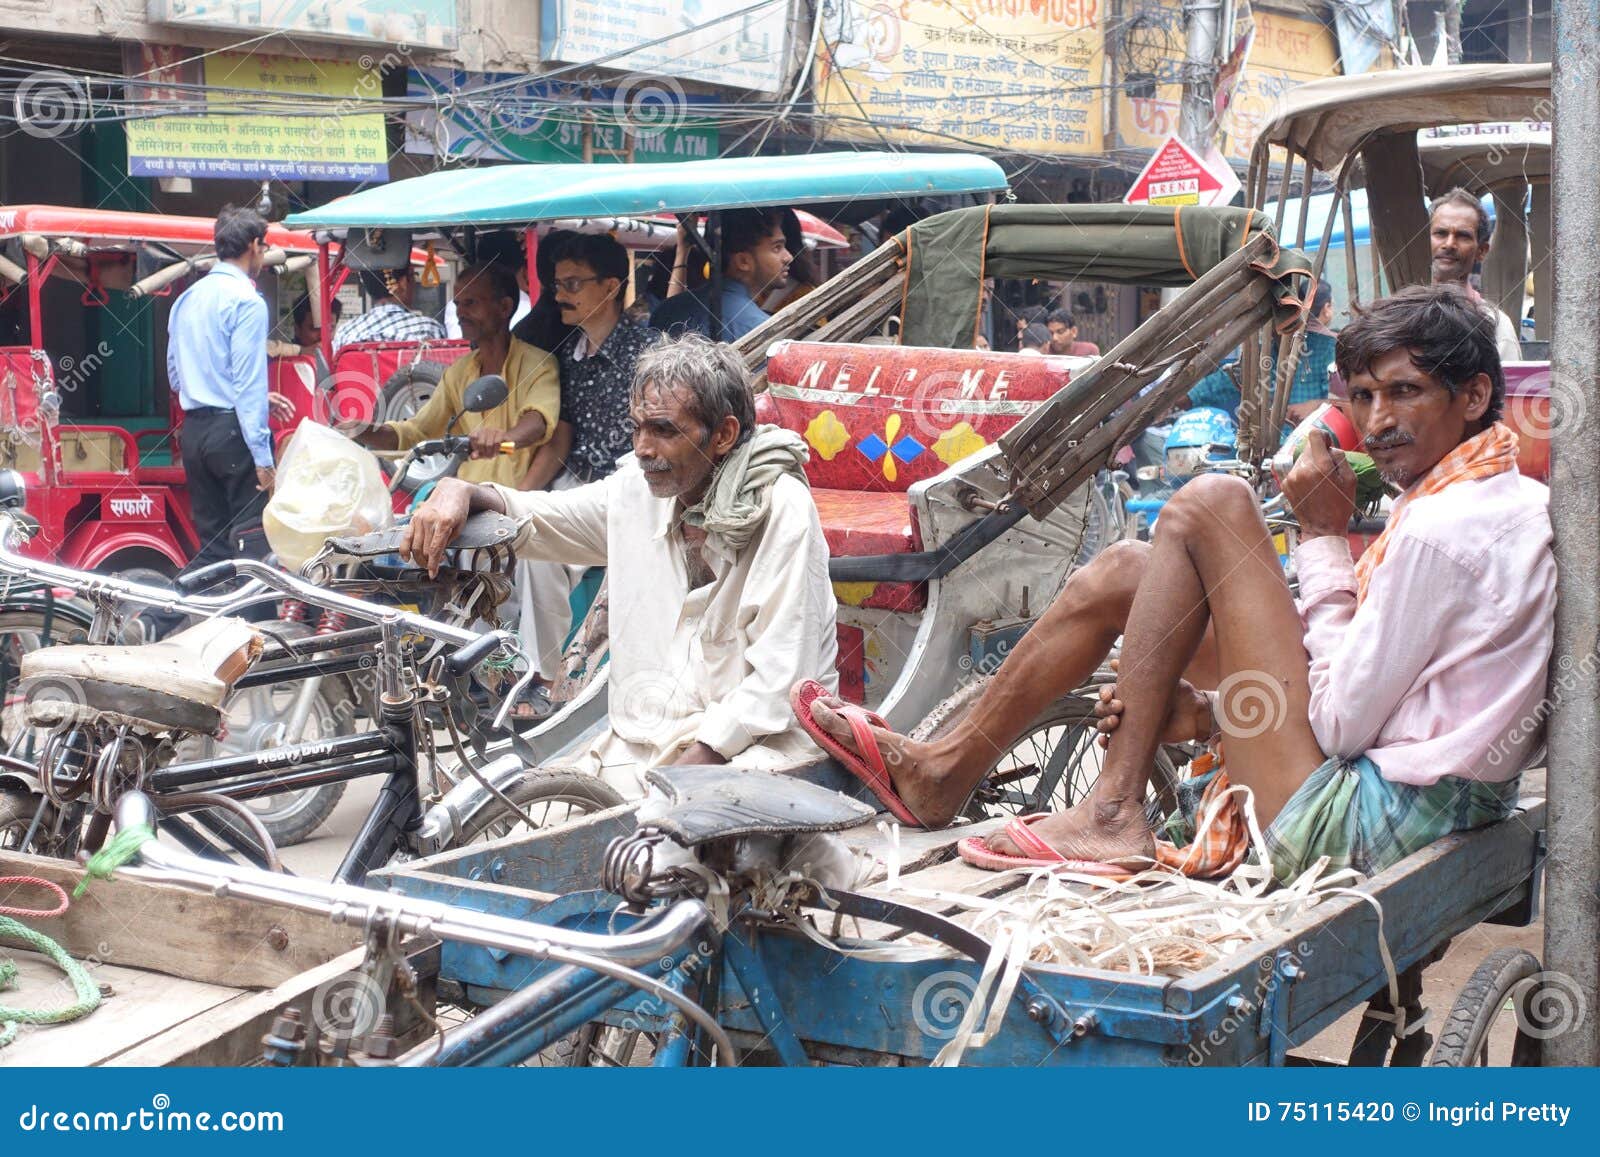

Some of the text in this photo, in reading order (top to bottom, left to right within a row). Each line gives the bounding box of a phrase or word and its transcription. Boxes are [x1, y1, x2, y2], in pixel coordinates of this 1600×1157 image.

[559, 123, 615, 148] STTE
[673, 135, 708, 157] ATM
[1150, 181, 1197, 195] ARENA
[109, 493, 155, 519] सफारी
